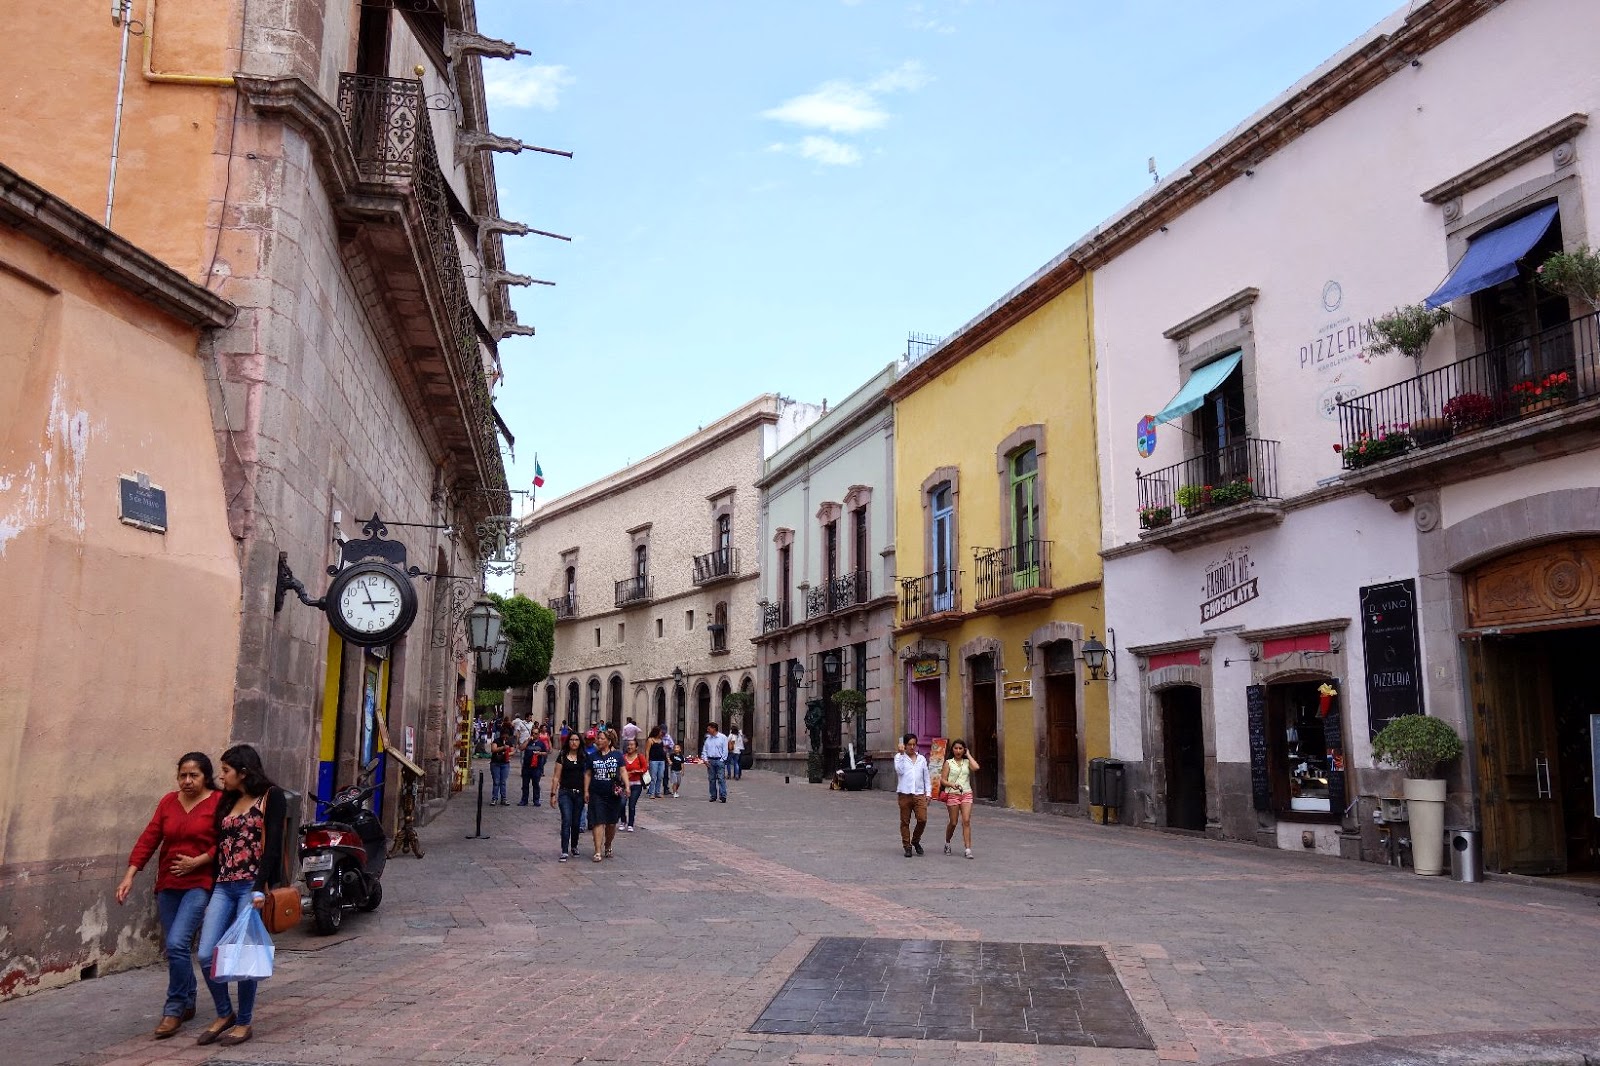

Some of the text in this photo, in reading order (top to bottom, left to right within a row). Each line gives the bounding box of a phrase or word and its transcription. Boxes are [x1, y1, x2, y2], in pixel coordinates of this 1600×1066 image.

[1238, 554, 1249, 583] DE
[368, 577, 378, 586] 12
[383, 579, 386, 589] 1
[347, 587, 357, 597] 10
[390, 588, 396, 596] 2
[344, 598, 349, 607] 9
[394, 598, 399, 607] 3
[1203, 581, 1254, 620] CHOCOLATE
[347, 610, 353, 618] 8
[389, 610, 395, 619] 4
[357, 618, 363, 627] 7
[368, 621, 374, 629] 6
[379, 618, 385, 627] 5
[1373, 671, 1411, 688] PIZZERIA
